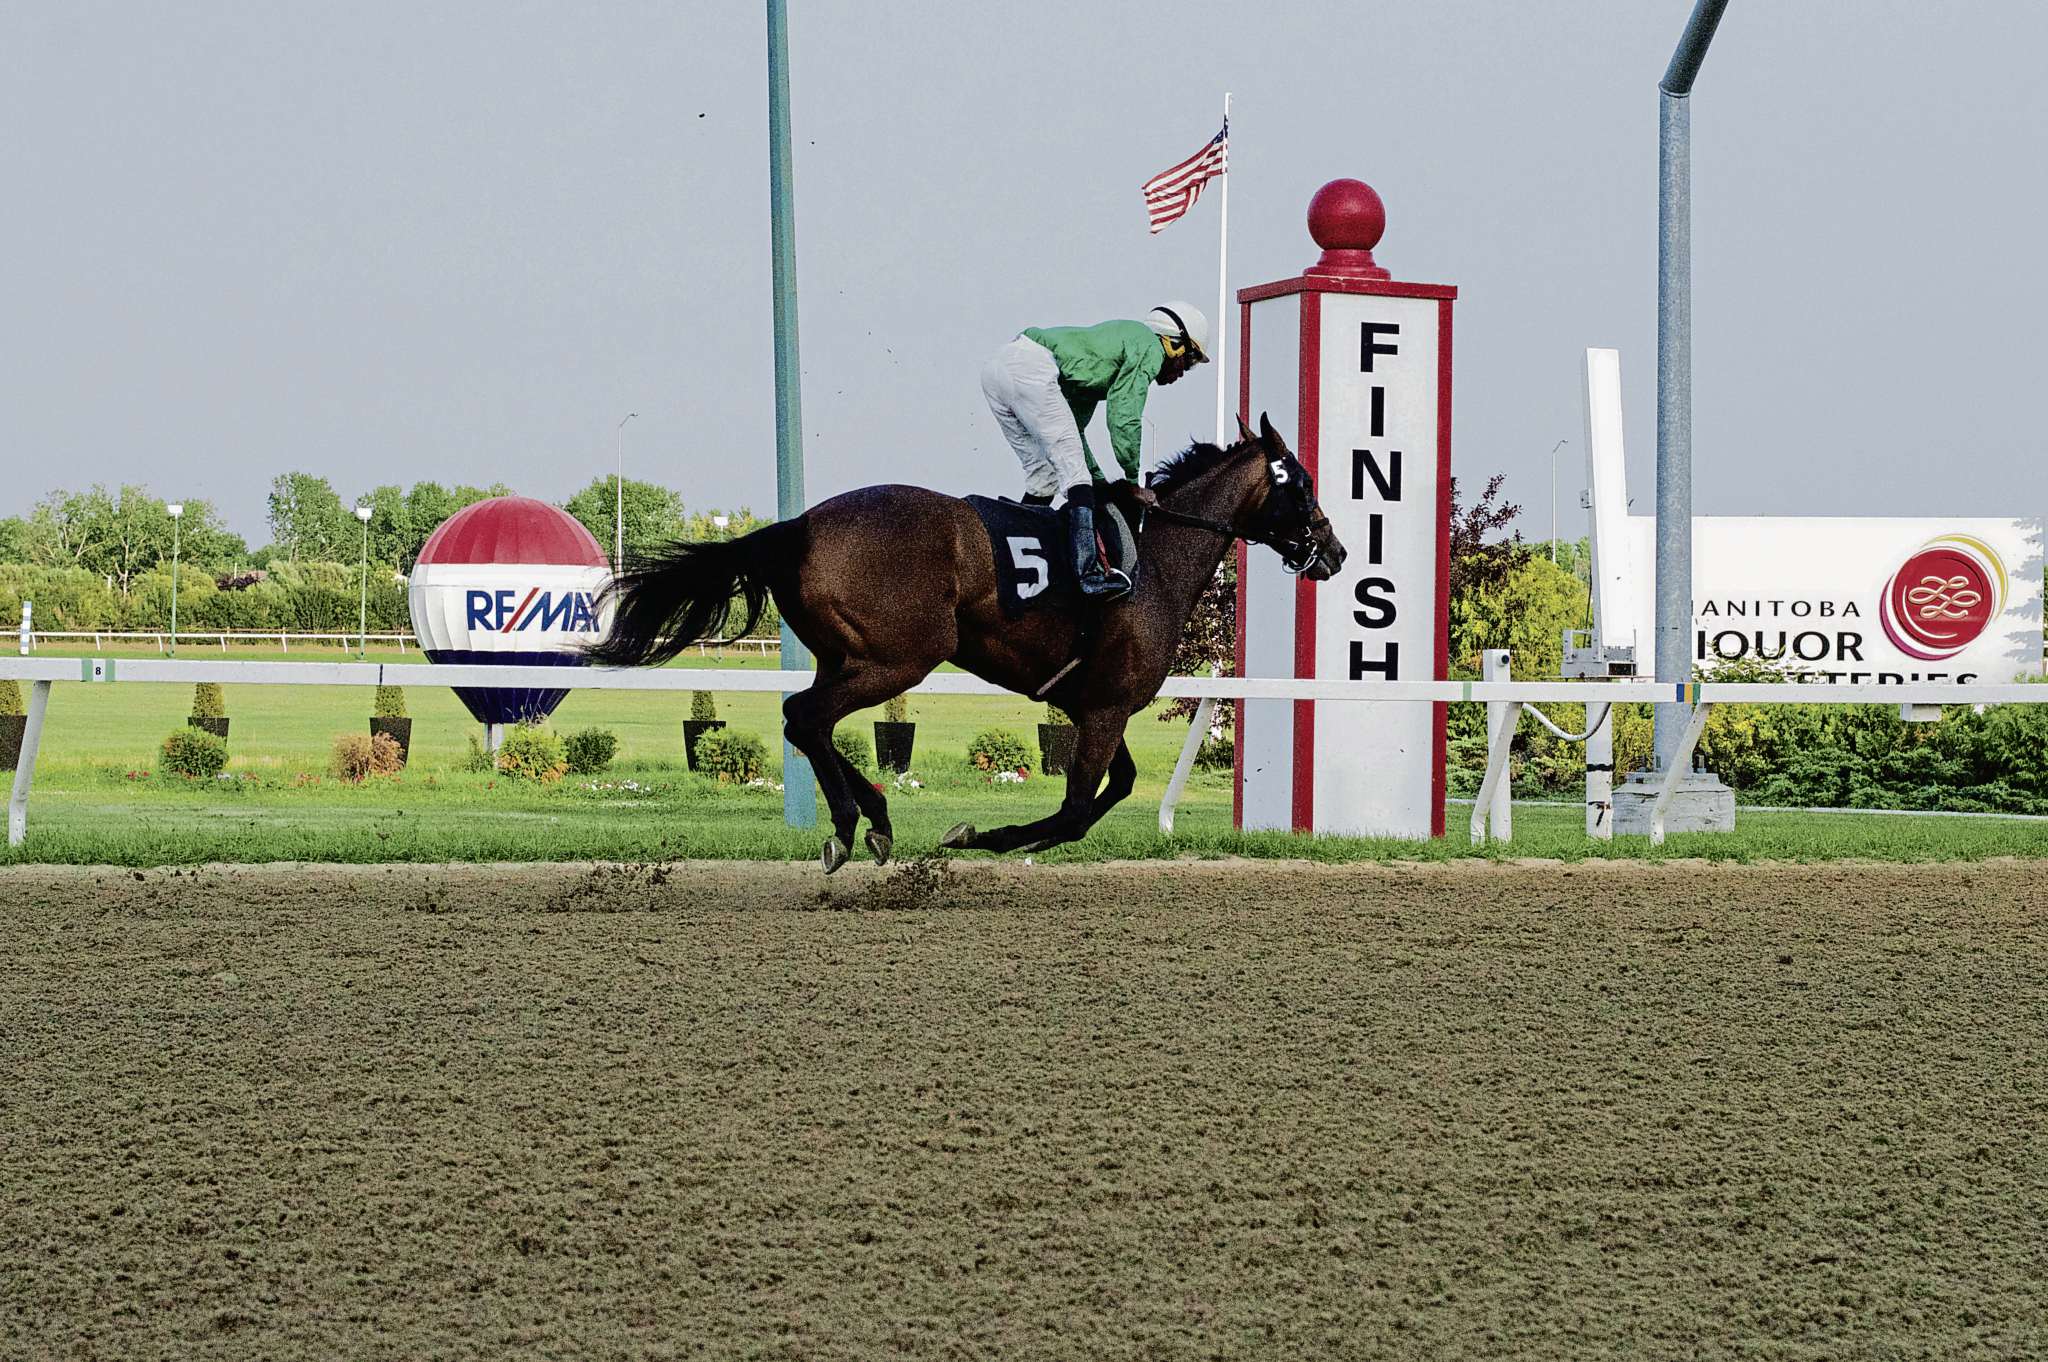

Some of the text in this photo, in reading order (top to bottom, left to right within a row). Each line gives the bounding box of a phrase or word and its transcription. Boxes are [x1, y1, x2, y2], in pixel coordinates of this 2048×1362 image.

[1270, 460, 1288, 484] 5
[1348, 321, 1402, 682] FINISH
[1006, 536, 1049, 600] 5
[1691, 600, 1861, 617] ANITOBA
[1697, 630, 1864, 661] IQUOR
[95, 666, 101, 675] 8
